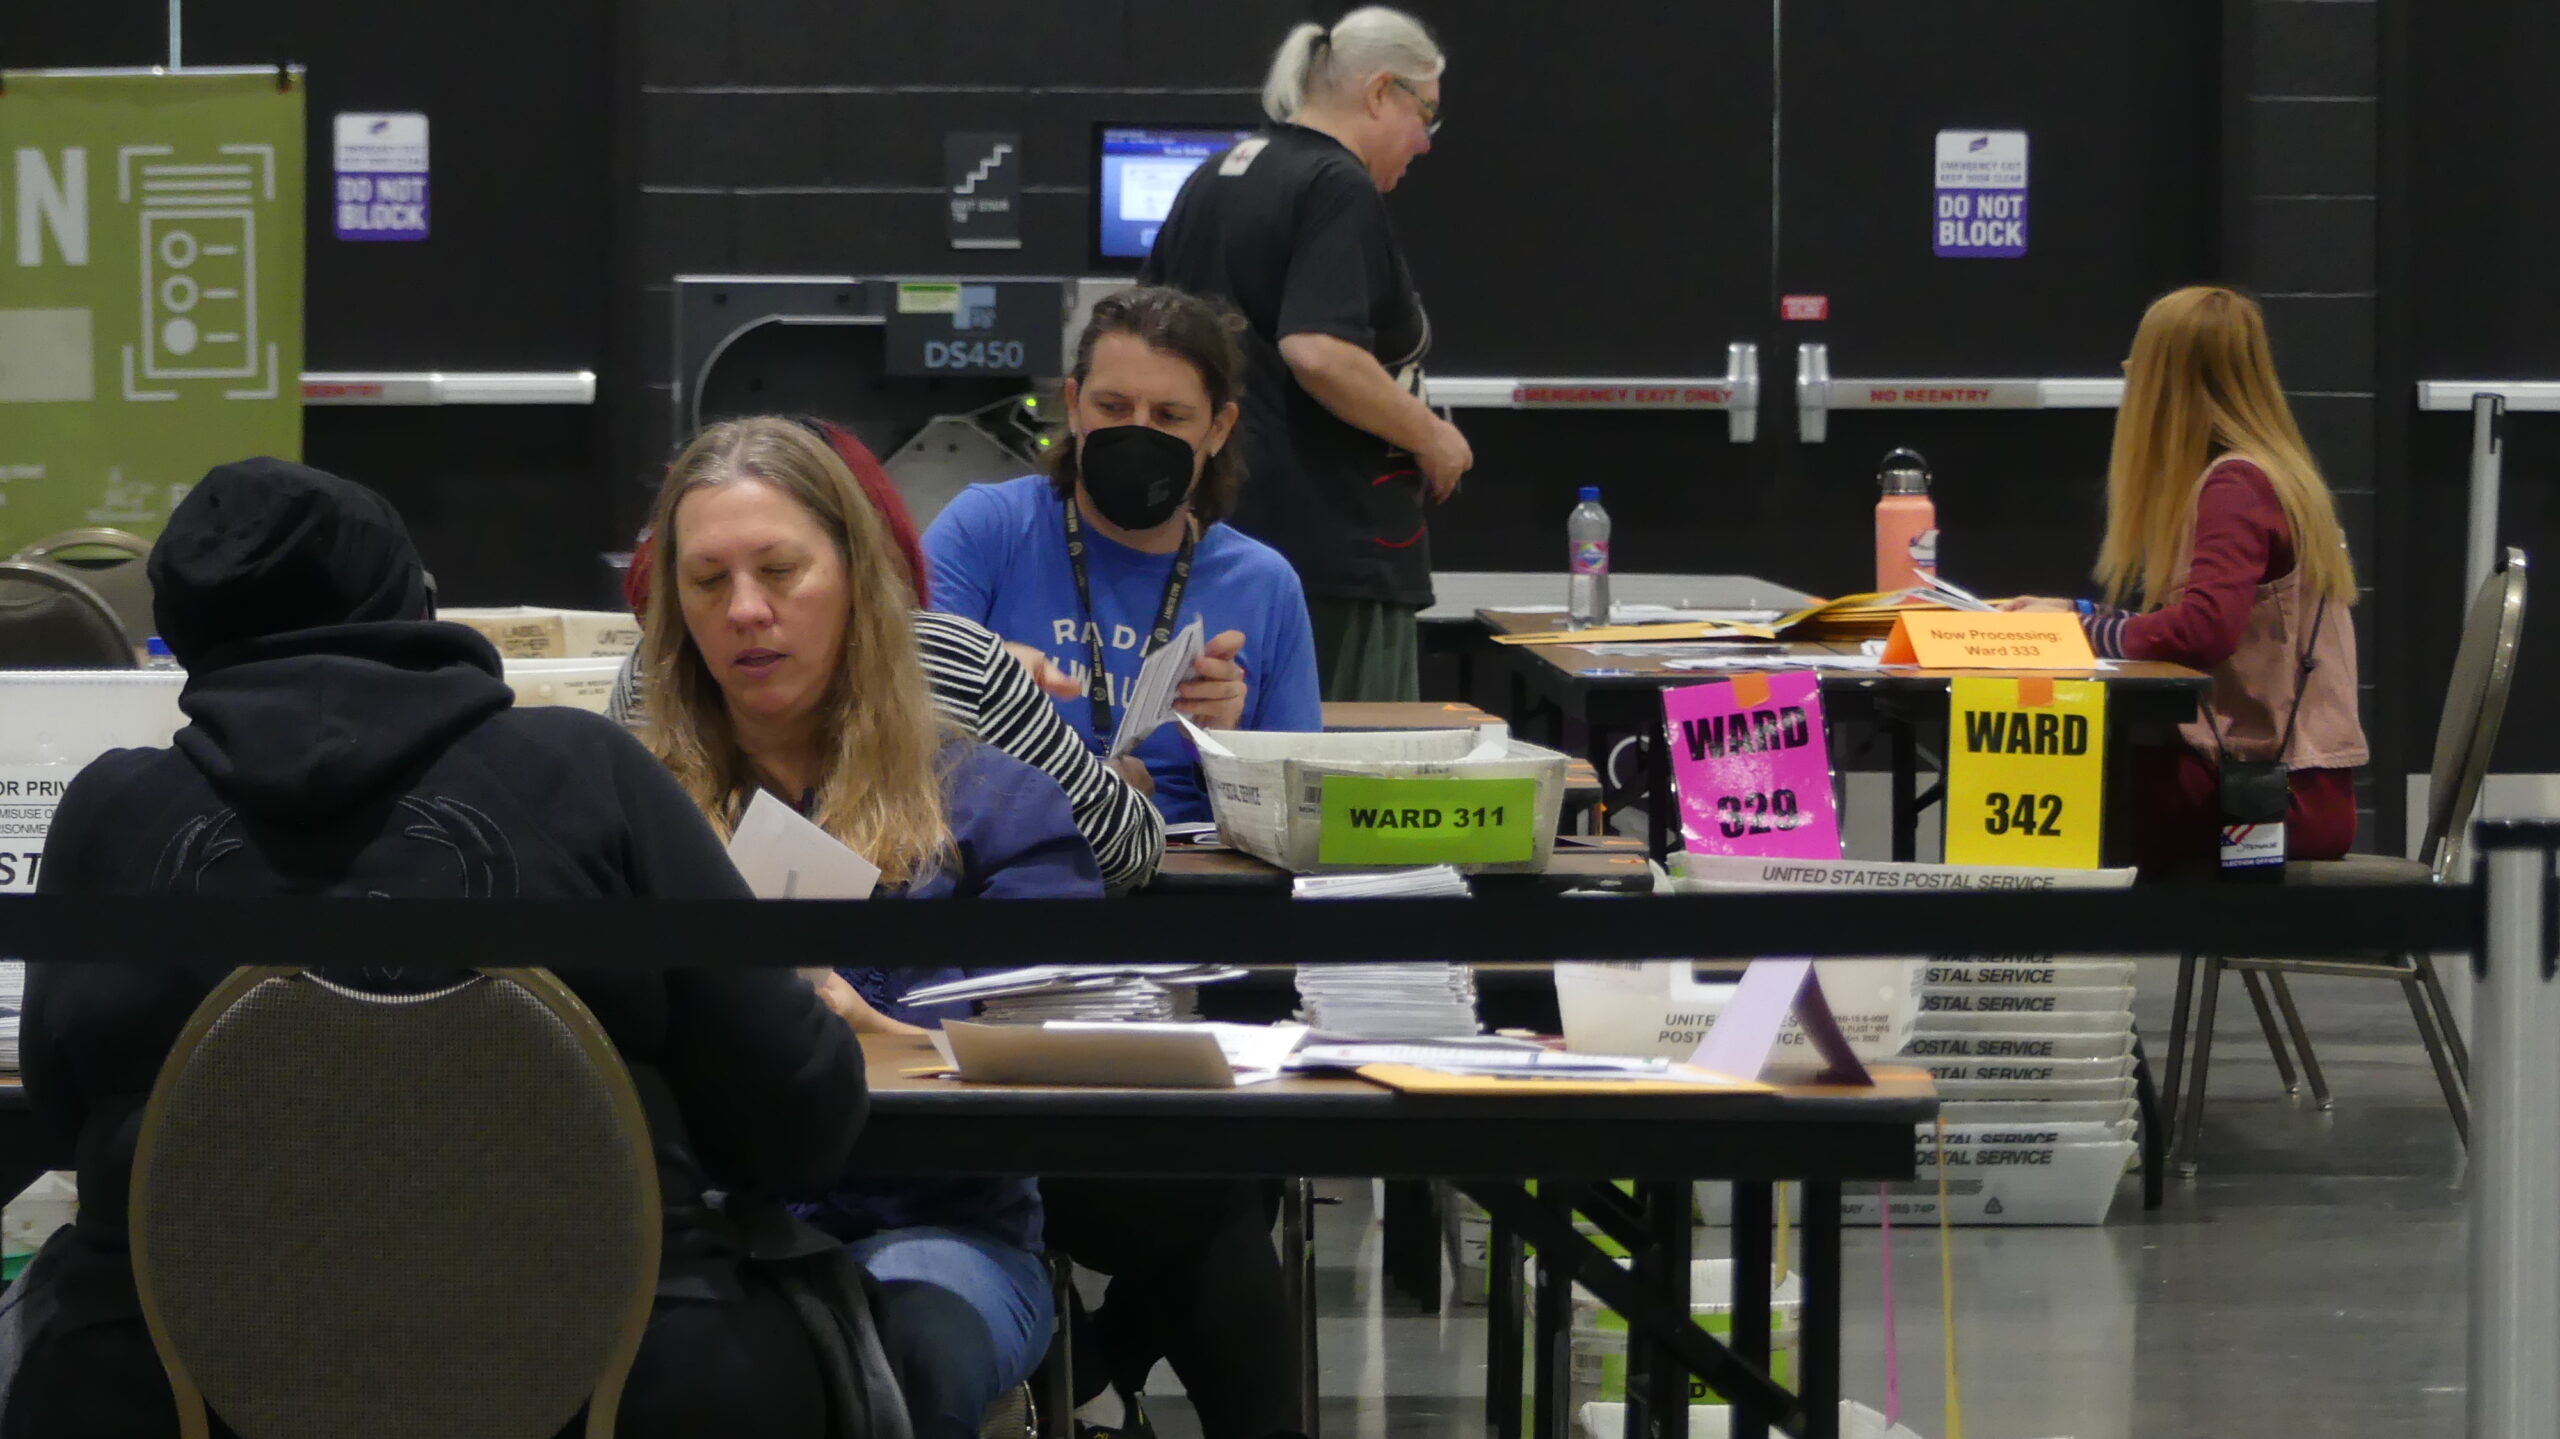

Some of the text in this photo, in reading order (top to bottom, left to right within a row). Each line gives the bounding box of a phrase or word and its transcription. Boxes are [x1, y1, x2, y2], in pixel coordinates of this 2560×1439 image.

[338, 177, 426, 202] DO NOT
[0, 146, 89, 268] N
[338, 204, 426, 230] BLOCK
[1938, 194, 2024, 219] DO NOT
[1938, 220, 2023, 247] BLOCK
[924, 340, 1025, 368] DS450
[1513, 388, 1733, 402] EMERGENCY EXIT ONLY
[1870, 389, 1989, 402] NO REENTRY
[1931, 629, 2062, 643] Now Processing:
[1965, 645, 2041, 657] Ward 333
[1683, 706, 1809, 761] WARD
[1965, 710, 2088, 756] WARD
[1349, 807, 1505, 829] WARD 311
[1984, 792, 2063, 837] 342
[0, 824, 50, 834] ISONME
[1762, 866, 2057, 890] UNITED STATES POSTAL SERVICE
[1925, 968, 2055, 983] STAL SERVICE
[1976, 997, 2056, 1012] SERVICE
[1665, 1014, 1720, 1027] UNITE
[1975, 1041, 2054, 1056] SERVICE
[1976, 1151, 2054, 1165] SERVICE
